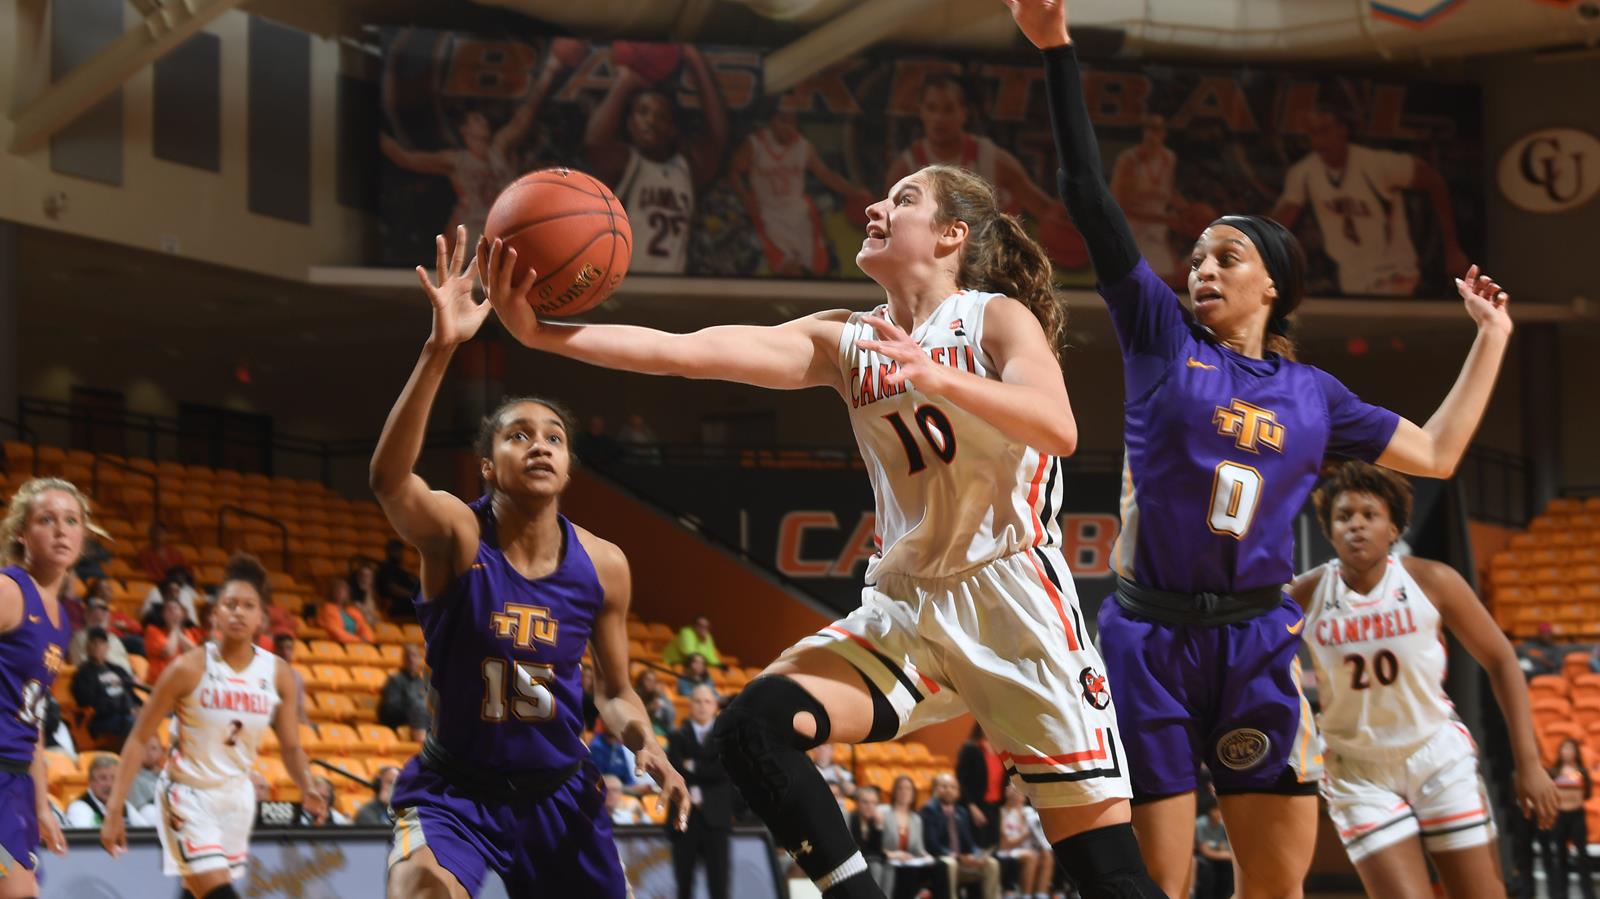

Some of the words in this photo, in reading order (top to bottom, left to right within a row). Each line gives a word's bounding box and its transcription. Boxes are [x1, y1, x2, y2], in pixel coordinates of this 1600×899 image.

[881, 404, 957, 476] 10
[1212, 398, 1286, 454] TTU
[1206, 459, 1264, 541] 0
[489, 601, 560, 651] TTU
[1315, 607, 1417, 647] CAMPBELL
[480, 656, 557, 722] 15
[1343, 648, 1399, 690] 20
[200, 687, 268, 715] CAMPBELL
[224, 719, 243, 747] 2
